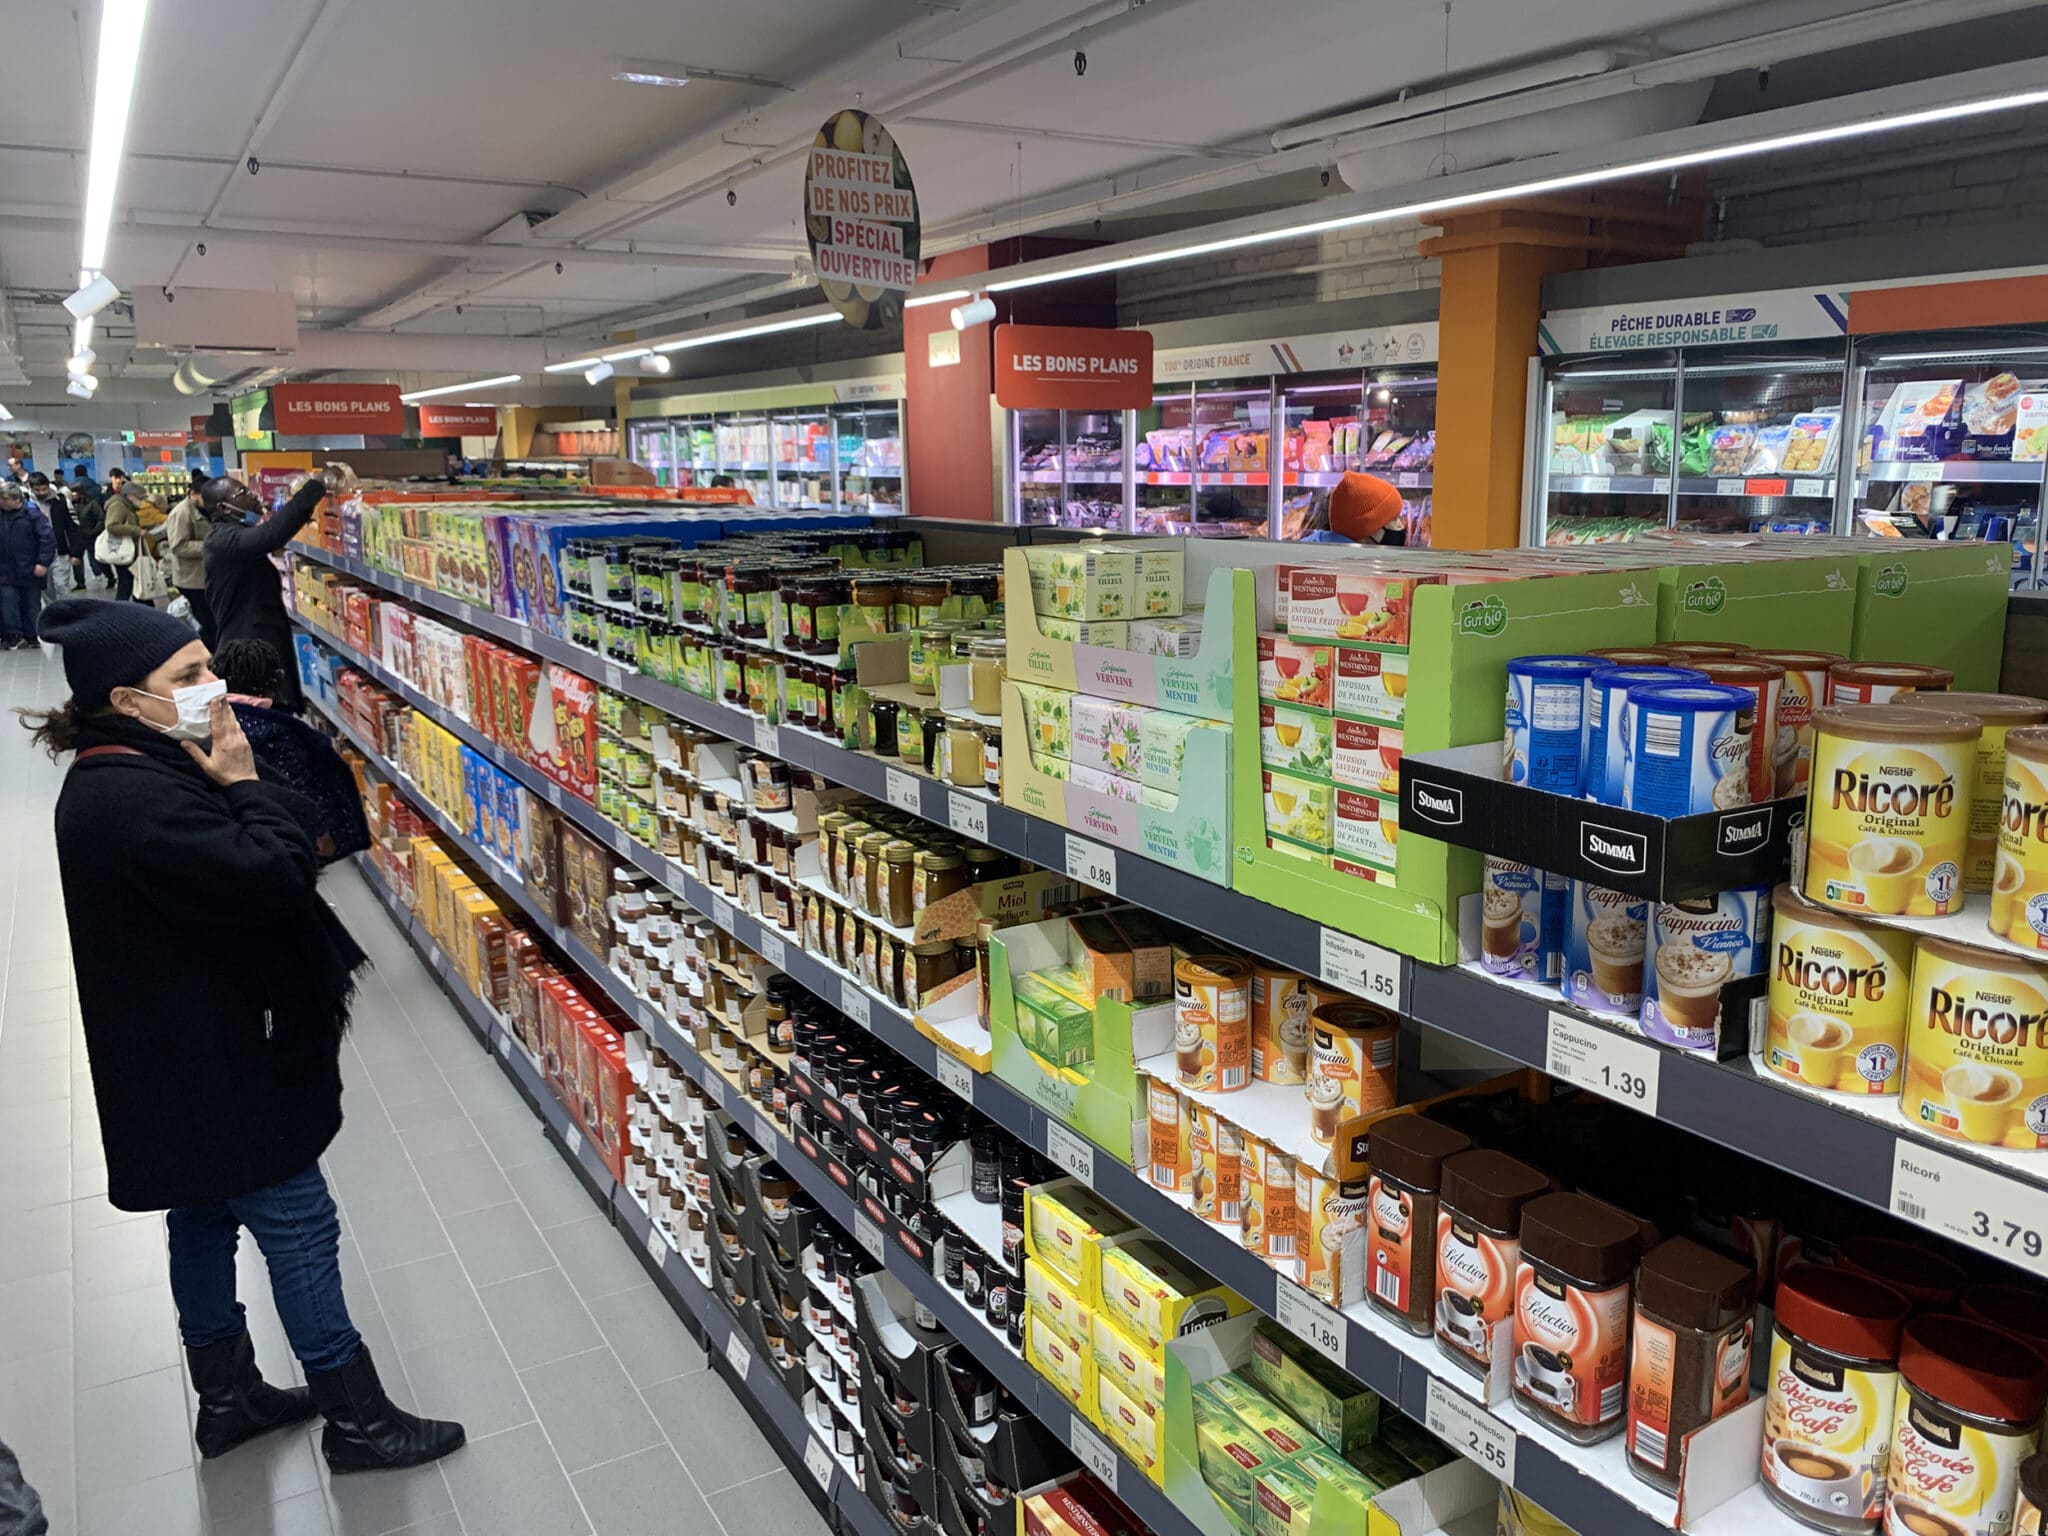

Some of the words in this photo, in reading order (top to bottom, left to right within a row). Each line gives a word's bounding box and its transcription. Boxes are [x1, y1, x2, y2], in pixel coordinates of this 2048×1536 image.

[815, 153, 892, 184] PROFITEZ
[814, 187, 835, 212] DE
[839, 190, 870, 214] NOS
[874, 193, 911, 217] PRIX
[835, 218, 901, 254] SPÉCIAL
[820, 249, 912, 285] OUVERTURE
[1611, 315, 1653, 332] PÊCHE
[1656, 311, 1721, 329] DURABLE
[1590, 333, 1644, 350] ÉLEVAGE
[1648, 326, 1747, 346] RESPONSABLE
[1013, 354, 1042, 372] LES
[1045, 356, 1086, 373] BONS
[1090, 357, 1138, 374] PLANS
[1183, 357, 1216, 370] ORIGINE
[1217, 353, 1250, 367] FRANCE
[288, 401, 312, 412] LES
[315, 401, 348, 412] BONS
[351, 401, 391, 413] PLANS
[429, 415, 444, 424] LES
[467, 416, 490, 424] PLANS
[1294, 586, 1335, 595] WESTMINSTER
[1688, 596, 1706, 607] GUT
[1705, 592, 1721, 607] bio
[1291, 606, 1324, 615] INFUSION
[1464, 616, 1482, 627] GUT
[1484, 611, 1501, 627] bio
[1291, 615, 1318, 625] SAVEUR
[1029, 647, 1051, 659] Infusion
[1027, 659, 1054, 672] TILLEUL
[1100, 661, 1128, 674] Infusion
[1166, 666, 1194, 678] Infusion
[1096, 672, 1134, 688] VERVEINE
[1161, 678, 1200, 692] VERVEINE
[1338, 679, 1371, 692] INFUSION
[1165, 690, 1198, 704] MENTHE
[1338, 690, 1347, 699] DE
[1348, 692, 1378, 705] PLANTES
[1074, 732, 1100, 745] VERVEINE
[1144, 752, 1172, 766] VERVEINE
[1336, 753, 1368, 767] INFUSION
[1146, 762, 1170, 775] MENTHE
[1336, 763, 1360, 774] SAVEUR
[1879, 766, 1914, 778] Nestlé
[1023, 793, 1047, 808] TILLEUL
[1419, 790, 1455, 815] SUMMA
[1832, 768, 1954, 819] Ricoré
[1088, 806, 1113, 821] Infusion
[1865, 814, 1920, 828] Original
[2000, 793, 2048, 844] coré
[968, 817, 984, 834] 4.49
[1084, 816, 1119, 836] VERVEINE
[1150, 821, 1173, 835] Infusion
[1337, 820, 1370, 835] INFUSION
[1725, 821, 1763, 844] SUMMA
[1858, 824, 1877, 834] Café
[1887, 828, 1925, 837] Chicorée
[1144, 831, 1178, 849] VERVEINE
[1337, 830, 1346, 840] DE
[1347, 834, 1377, 849] PLANTES
[1590, 834, 1636, 862] SUMMA
[1148, 842, 1177, 860] MENTHE
[1090, 865, 1111, 885] 0.89
[998, 891, 1027, 910] Miel
[1655, 906, 1743, 935] Cappuccino
[1325, 939, 1353, 956] Infusions
[1354, 949, 1365, 960] Bio
[1701, 936, 1745, 950] Viennois
[1811, 945, 1841, 959] Nestlé
[1777, 943, 1886, 1002] Ricoré
[1361, 969, 1393, 996] 1.55
[1177, 998, 1208, 1011] puccino
[1799, 990, 1849, 1008] Original
[1976, 991, 2012, 1005] Nestlé
[1794, 999, 1811, 1010] Café
[1819, 1004, 1854, 1017] Chicorée
[1552, 1028, 1597, 1050] Cappucino
[1677, 1029, 1686, 1037] 13
[1953, 1047, 1973, 1060] Café
[1974, 1052, 1981, 1061] &
[1983, 1054, 2024, 1067] Chicorée
[1960, 1039, 2019, 1057] Original
[1601, 1065, 1646, 1099] 1.39
[1071, 1154, 1089, 1177] 0.89
[1901, 1159, 1941, 1182] Ricoré
[1972, 1211, 2042, 1257] 3.79
[1445, 1243, 1488, 1282] Sélection
[991, 1292, 1004, 1304] 75
[1521, 1296, 1578, 1337] Sélection
[1310, 1322, 1338, 1352] 1.89
[1777, 1370, 1857, 1414] Chicorée
[1447, 1399, 1472, 1420] soluble
[1788, 1399, 1844, 1435] Café
[1469, 1431, 1506, 1469] 2.55
[1898, 1418, 1975, 1475] Chicorée
[1093, 1455, 1113, 1482] 0.92
[1904, 1451, 1960, 1494] Café
